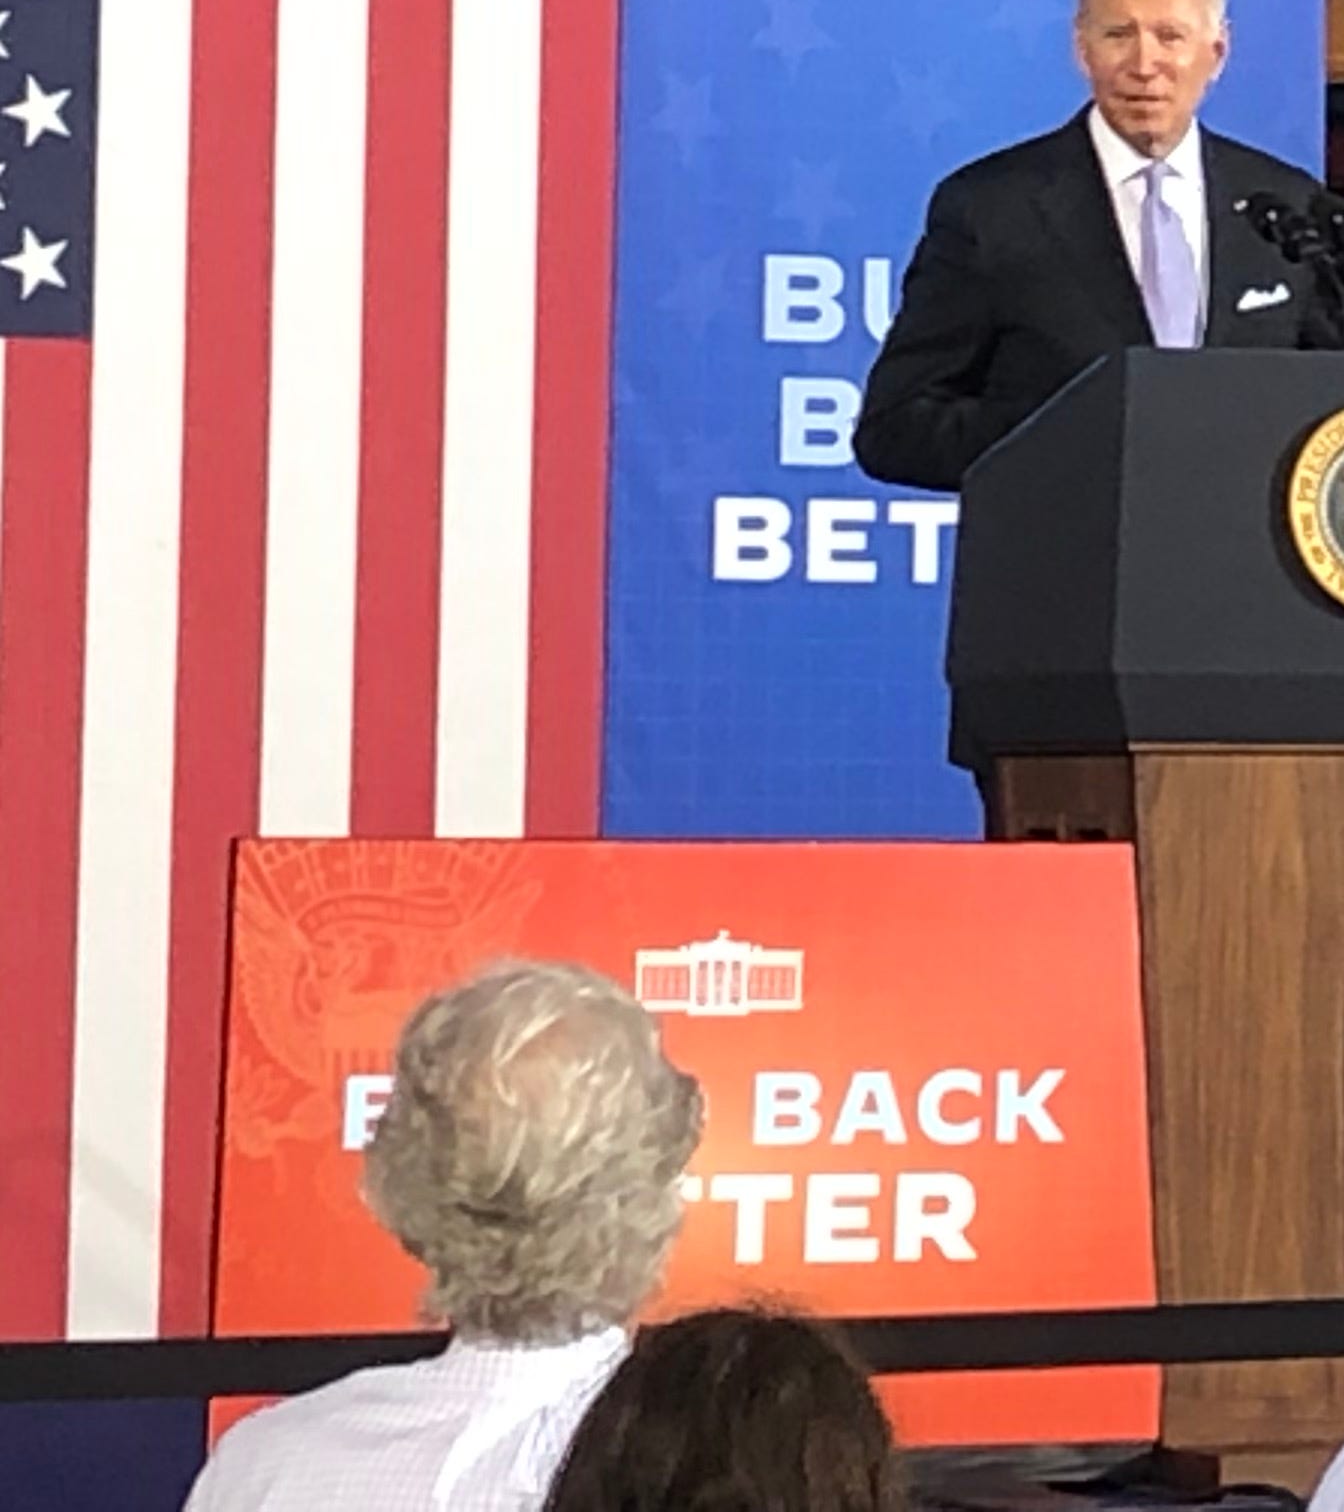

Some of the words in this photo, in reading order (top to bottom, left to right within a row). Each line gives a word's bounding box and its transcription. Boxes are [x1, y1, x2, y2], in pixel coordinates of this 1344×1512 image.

[713, 497, 960, 584] BET
[752, 1069, 1067, 1145] BACK
[681, 1172, 978, 1265] TER
